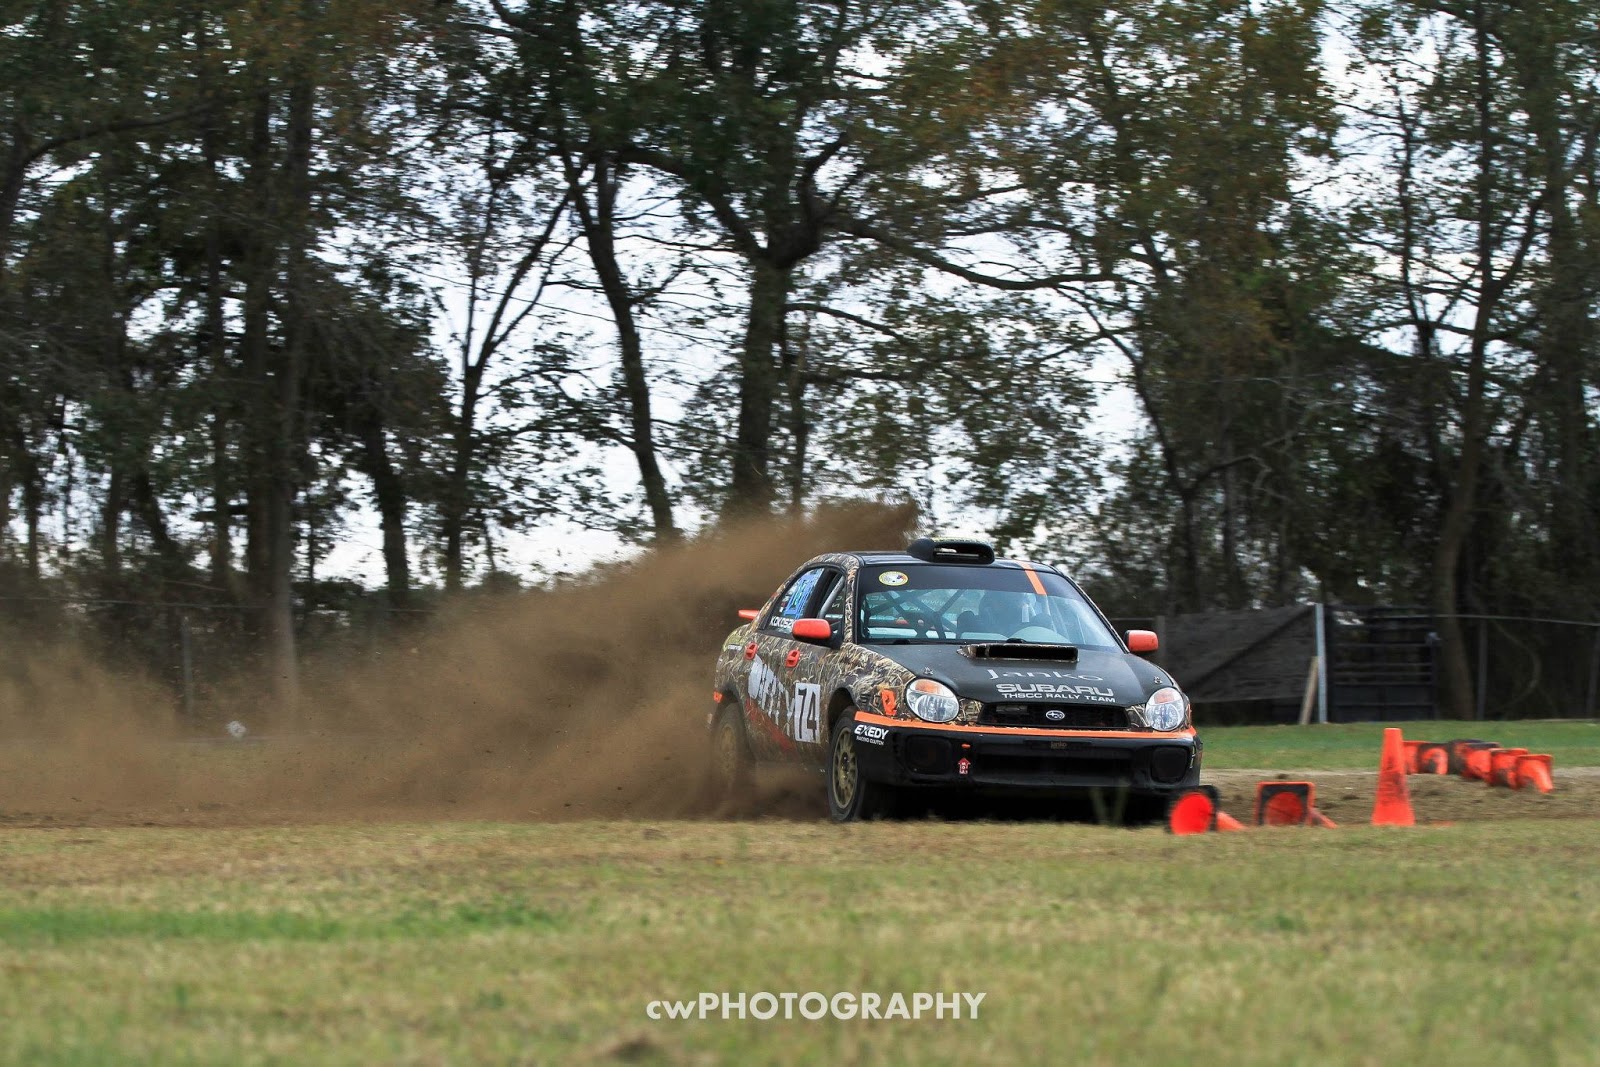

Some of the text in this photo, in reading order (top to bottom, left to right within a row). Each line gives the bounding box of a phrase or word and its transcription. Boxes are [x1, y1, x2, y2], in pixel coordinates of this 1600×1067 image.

[987, 669, 1103, 681] Janko
[996, 683, 1114, 697] SUBARU
[1085, 695, 1116, 703] TEAM
[797, 687, 818, 741] 74
[854, 724, 889, 740] EXEDY
